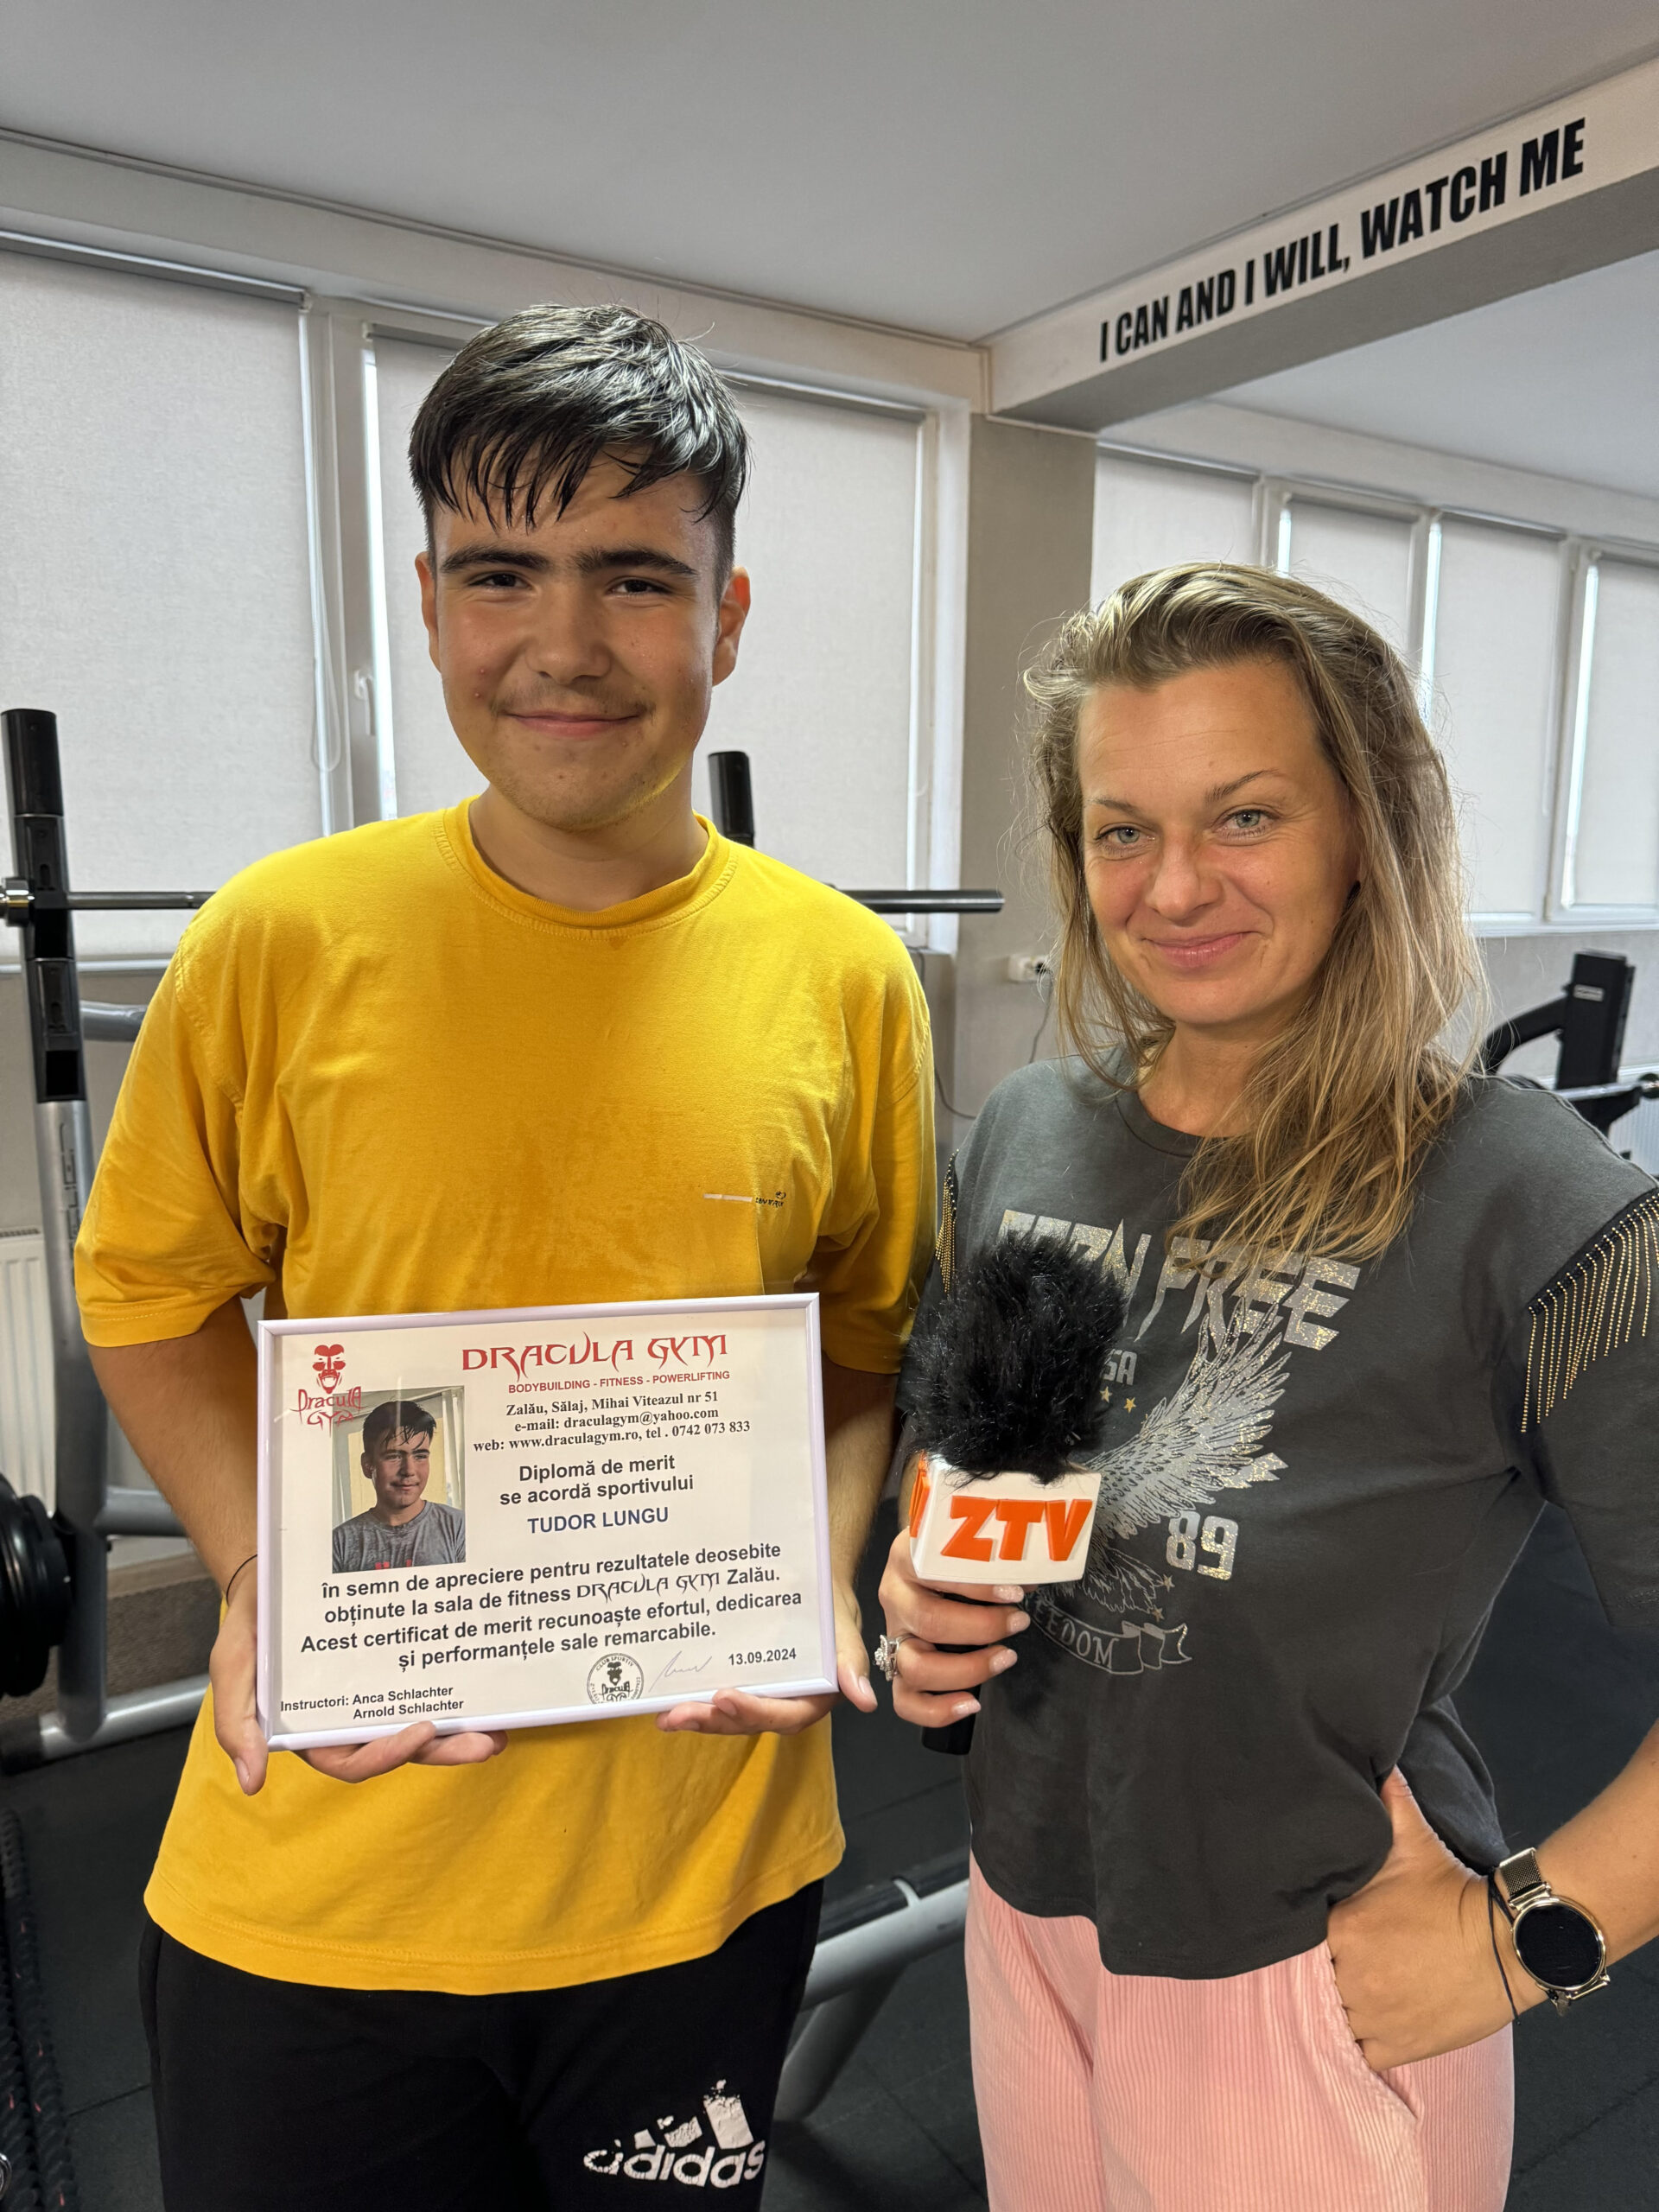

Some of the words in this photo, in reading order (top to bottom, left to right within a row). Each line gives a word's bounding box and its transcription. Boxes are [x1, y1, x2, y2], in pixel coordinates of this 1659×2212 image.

[1100, 321, 1110, 362] I
[1115, 296, 1170, 355] CAN
[1176, 269, 1236, 334] AND
[1244, 259, 1255, 306] I
[1263, 224, 1351, 299] WILL,
[1360, 151, 1508, 259] WATCH
[1519, 118, 1586, 197] ME
[461, 1332, 633, 1382] DRACULA
[647, 1334, 728, 1370] GYM
[1098, 1349, 1138, 1386] SA
[508, 1378, 591, 1394] BODYBUILDING
[600, 1375, 644, 1389] FITNESS
[652, 1370, 730, 1384] POWERLIFTING
[506, 1402, 548, 1417] Zalău,
[551, 1399, 588, 1414] Sălaj,
[591, 1397, 630, 1411] Mihai
[632, 1392, 683, 1408] Viteazul
[687, 1394, 702, 1404] nr
[704, 1390, 718, 1403] 51
[514, 1419, 560, 1433] e-mail:
[563, 1408, 719, 1429] draculagym@yahoo.com
[474, 1439, 505, 1452] web:
[508, 1430, 643, 1450] www.draculagym.ro,
[645, 1427, 662, 1440] tel
[671, 1424, 701, 1438] 0742
[704, 1422, 726, 1435] 073
[729, 1420, 751, 1433] 833
[519, 1459, 596, 1484] Diplomă
[601, 1459, 623, 1475] de
[629, 1454, 676, 1473] merit
[499, 1491, 522, 1505] se
[527, 1482, 591, 1503] acordă
[597, 1474, 694, 1500] sportivului
[527, 1512, 597, 1534] TUDOR
[602, 1506, 670, 1528] LUNGU
[940, 1495, 1093, 1562] ZTV
[1166, 1510, 1239, 1581] 89
[321, 1581, 340, 1599] în
[346, 1579, 400, 1597] semn
[406, 1574, 429, 1592] de
[435, 1567, 524, 1592] apreciere
[530, 1560, 590, 1585] pentru
[596, 1550, 690, 1574] rezultatele
[695, 1542, 781, 1564] deosebite
[324, 1602, 405, 1626] obținute
[412, 1599, 428, 1616] la
[434, 1595, 473, 1614] sala
[479, 1592, 502, 1610] de
[507, 1586, 571, 1607] fitness
[576, 1573, 669, 1604] DRACULA
[676, 1572, 721, 1595] GYM
[727, 1566, 780, 1586] Zalău.
[301, 1633, 358, 1653] Acest
[363, 1623, 448, 1648] certificat
[454, 1621, 478, 1638] de
[484, 1616, 533, 1636] merit
[537, 1605, 641, 1630] recunoaște
[646, 1598, 710, 1619] efortul,
[715, 1592, 802, 1613] dedicarea
[398, 1650, 415, 1673] și
[422, 1637, 555, 1669] performanțele
[560, 1632, 598, 1651] sale
[604, 1621, 716, 1647] remarcabile.
[728, 1646, 798, 1666] 13.09.2024
[280, 1694, 349, 1712] Instructori:
[353, 1694, 385, 1706] Anca
[388, 1687, 454, 1702] Schlachter
[353, 1705, 395, 1719] Arnold
[398, 1699, 465, 1715] Schlachter
[583, 2140, 766, 2189] adidas
